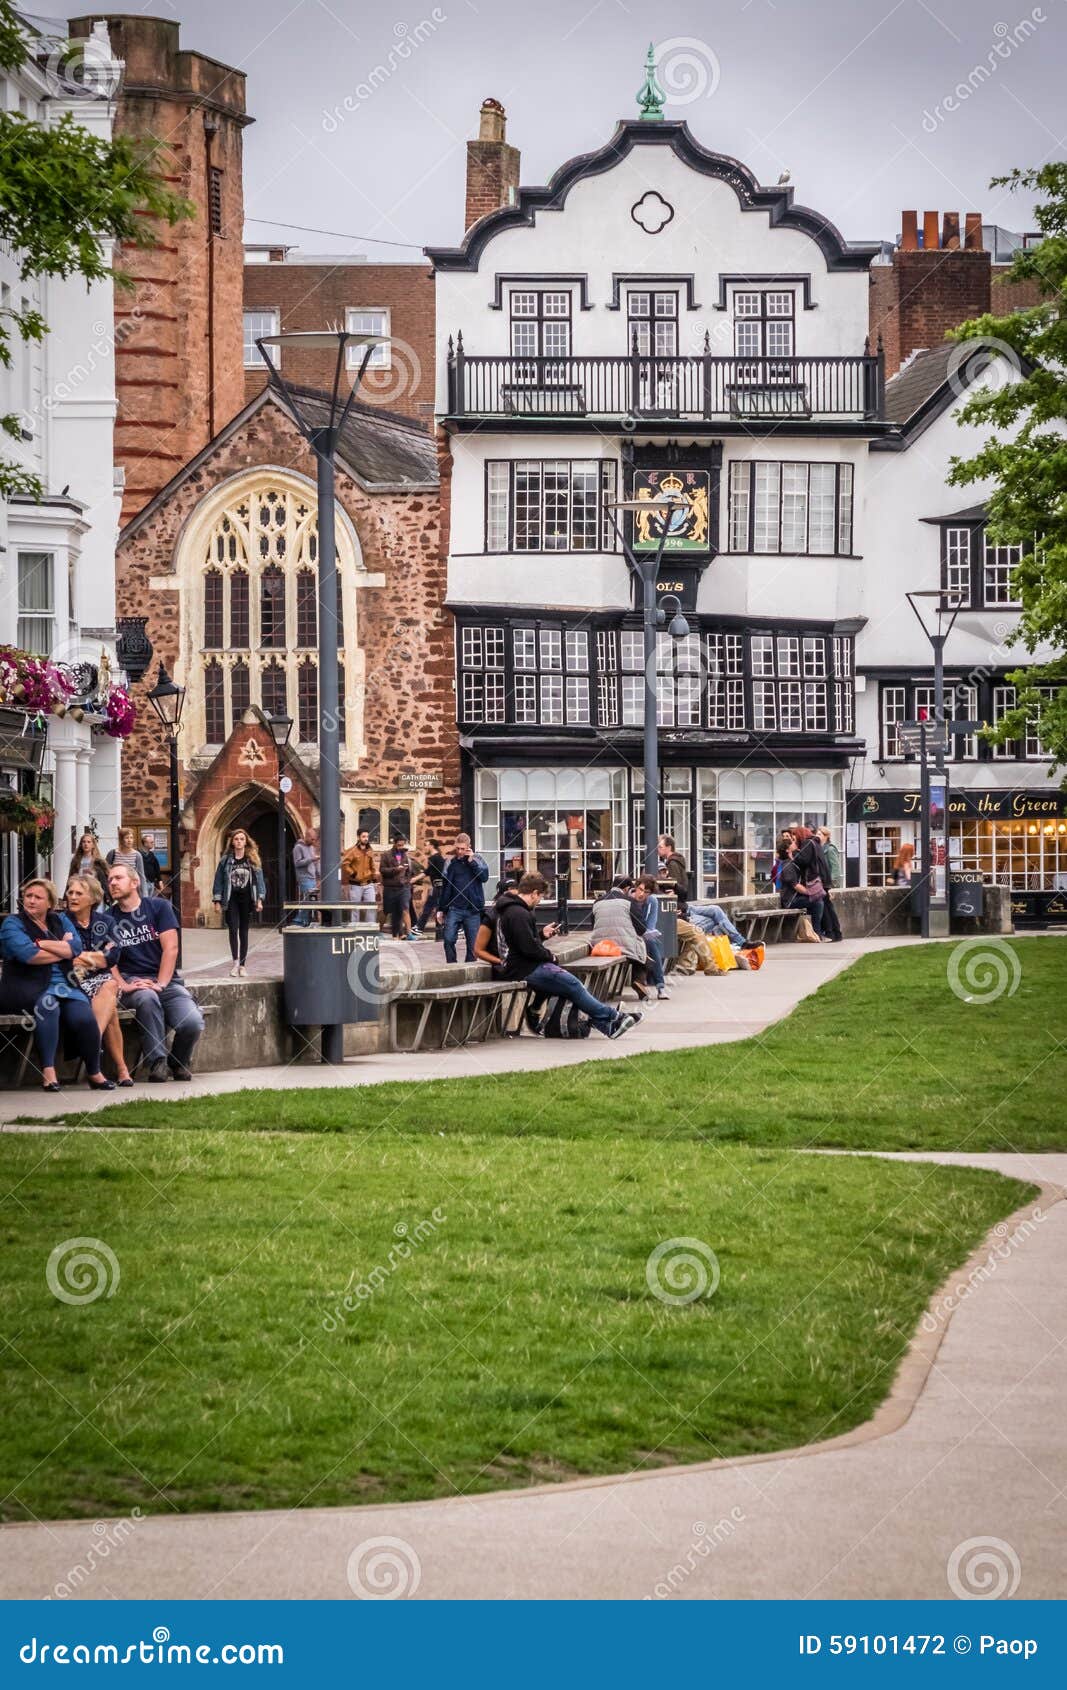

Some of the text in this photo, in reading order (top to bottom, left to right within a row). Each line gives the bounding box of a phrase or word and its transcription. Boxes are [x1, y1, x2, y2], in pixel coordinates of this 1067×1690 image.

[949, 801, 966, 812] on
[978, 794, 1001, 812] the
[1013, 793, 1057, 817] Green
